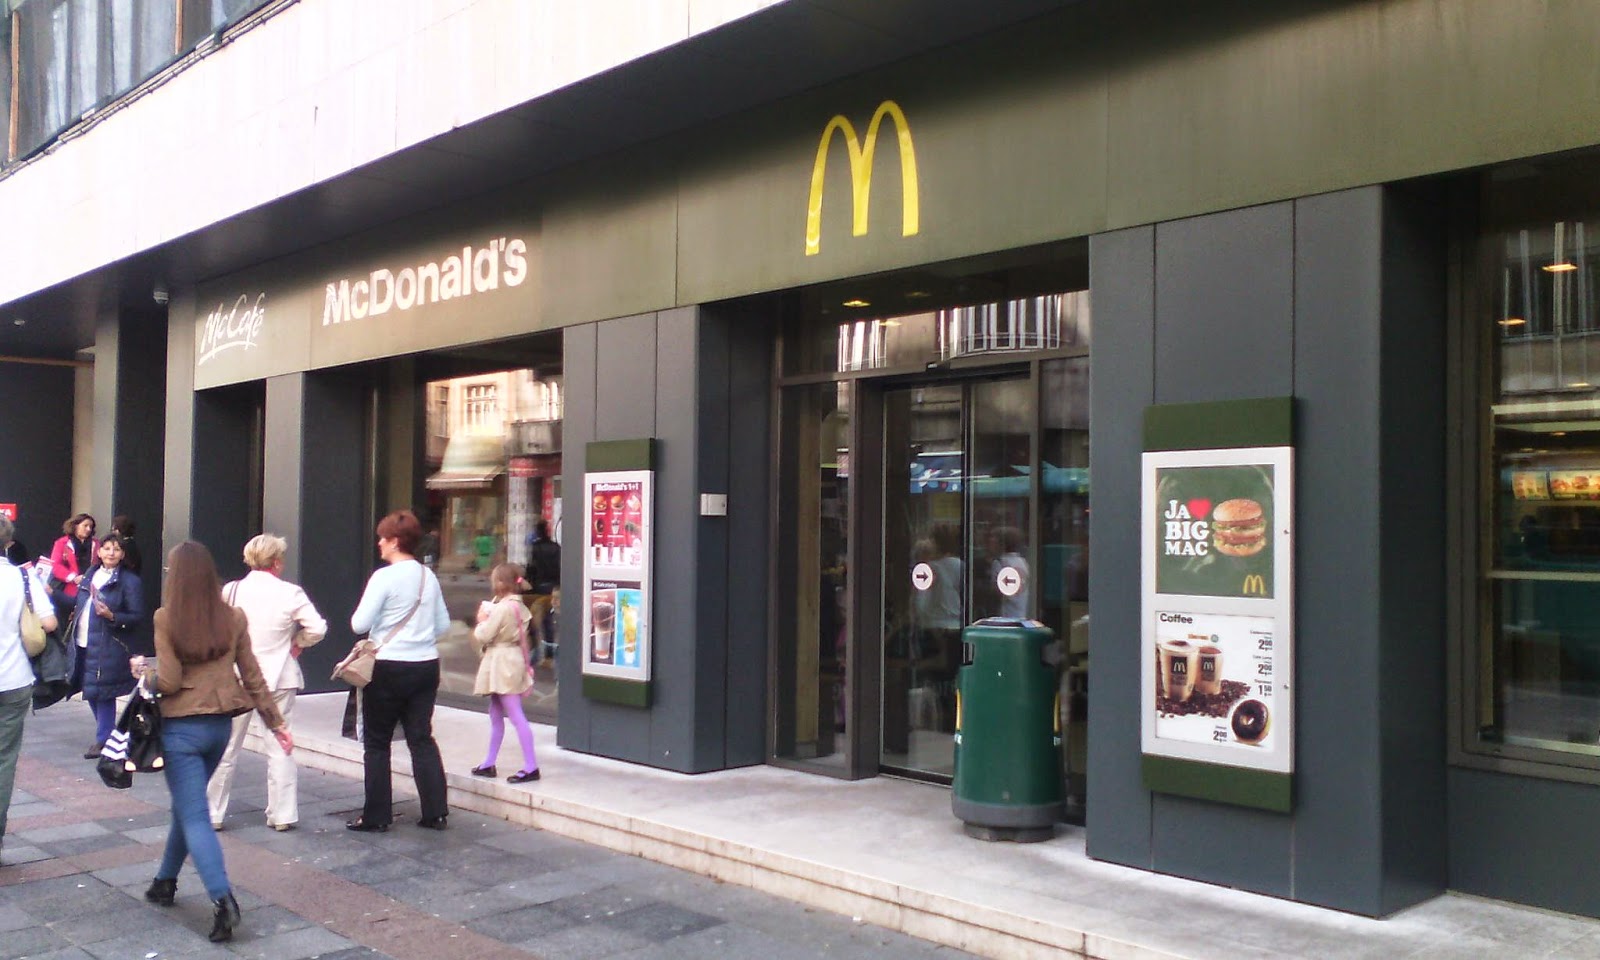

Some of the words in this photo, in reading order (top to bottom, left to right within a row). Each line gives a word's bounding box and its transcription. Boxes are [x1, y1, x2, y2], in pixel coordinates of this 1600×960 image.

[322, 237, 528, 326] McDonald's
[199, 292, 265, 365] McCafé
[1164, 499, 1191, 520] JA
[1165, 521, 1210, 541] BIG
[1165, 541, 1208, 556] MAC
[1159, 613, 1193, 624] Coffee
